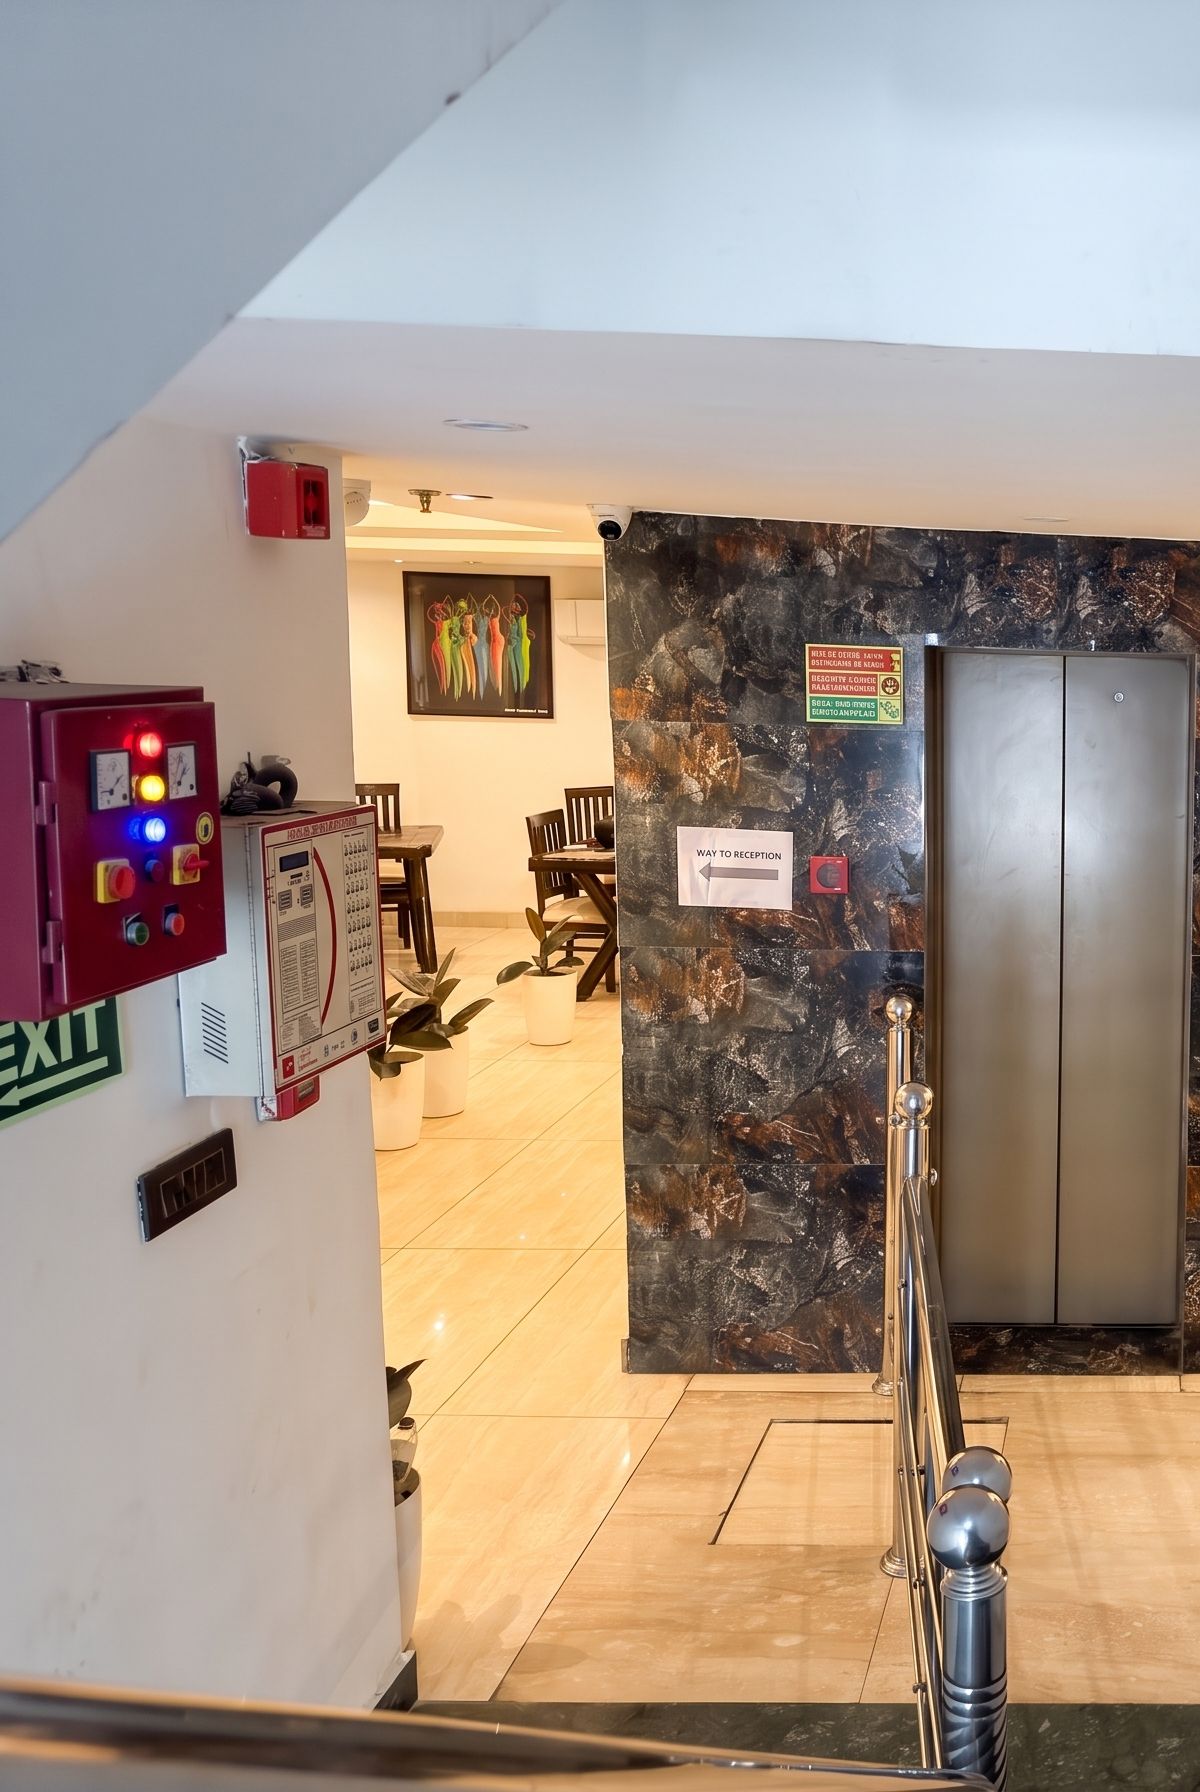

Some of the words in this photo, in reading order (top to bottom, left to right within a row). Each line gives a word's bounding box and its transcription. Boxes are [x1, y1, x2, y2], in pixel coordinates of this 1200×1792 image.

[696, 849, 717, 858] WAY
[719, 850, 732, 858] TO
[733, 850, 782, 860] RECEPTION
